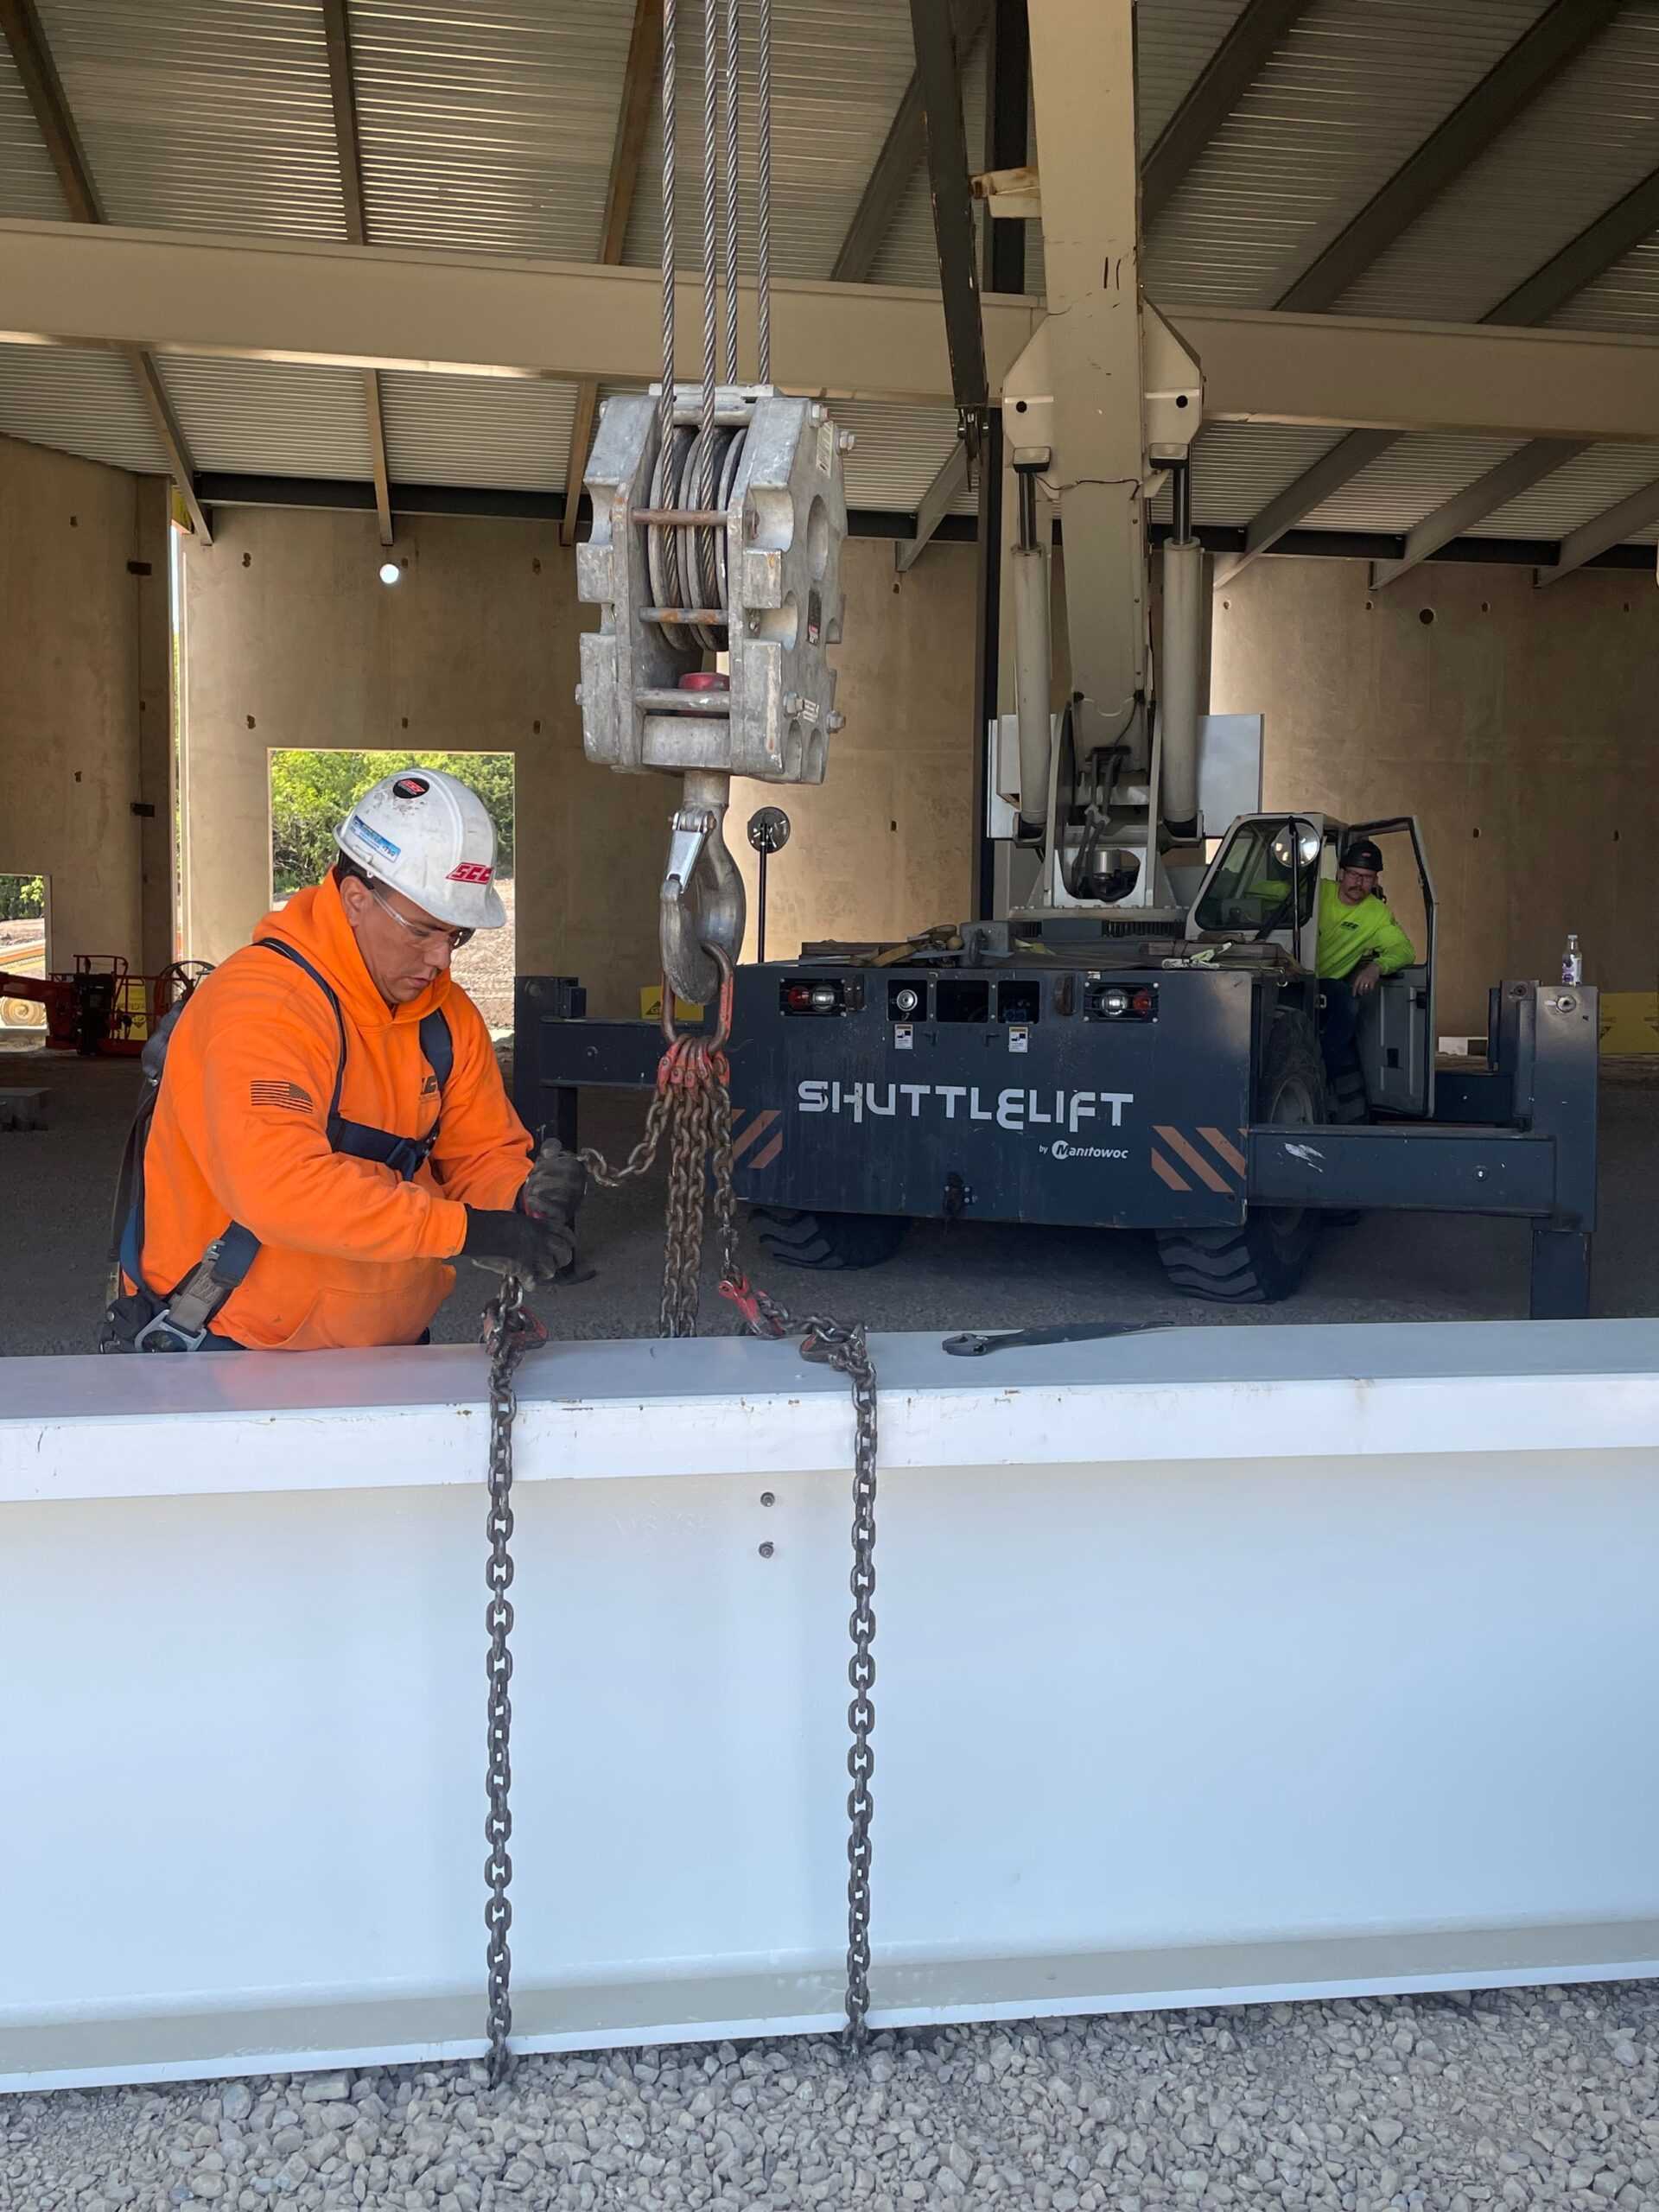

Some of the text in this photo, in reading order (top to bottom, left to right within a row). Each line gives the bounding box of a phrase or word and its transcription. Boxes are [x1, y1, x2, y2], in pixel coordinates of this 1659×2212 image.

[798, 1080, 1135, 1133] SHUTTLELIFT
[1039, 1140, 1129, 1160] by Manitowoc
